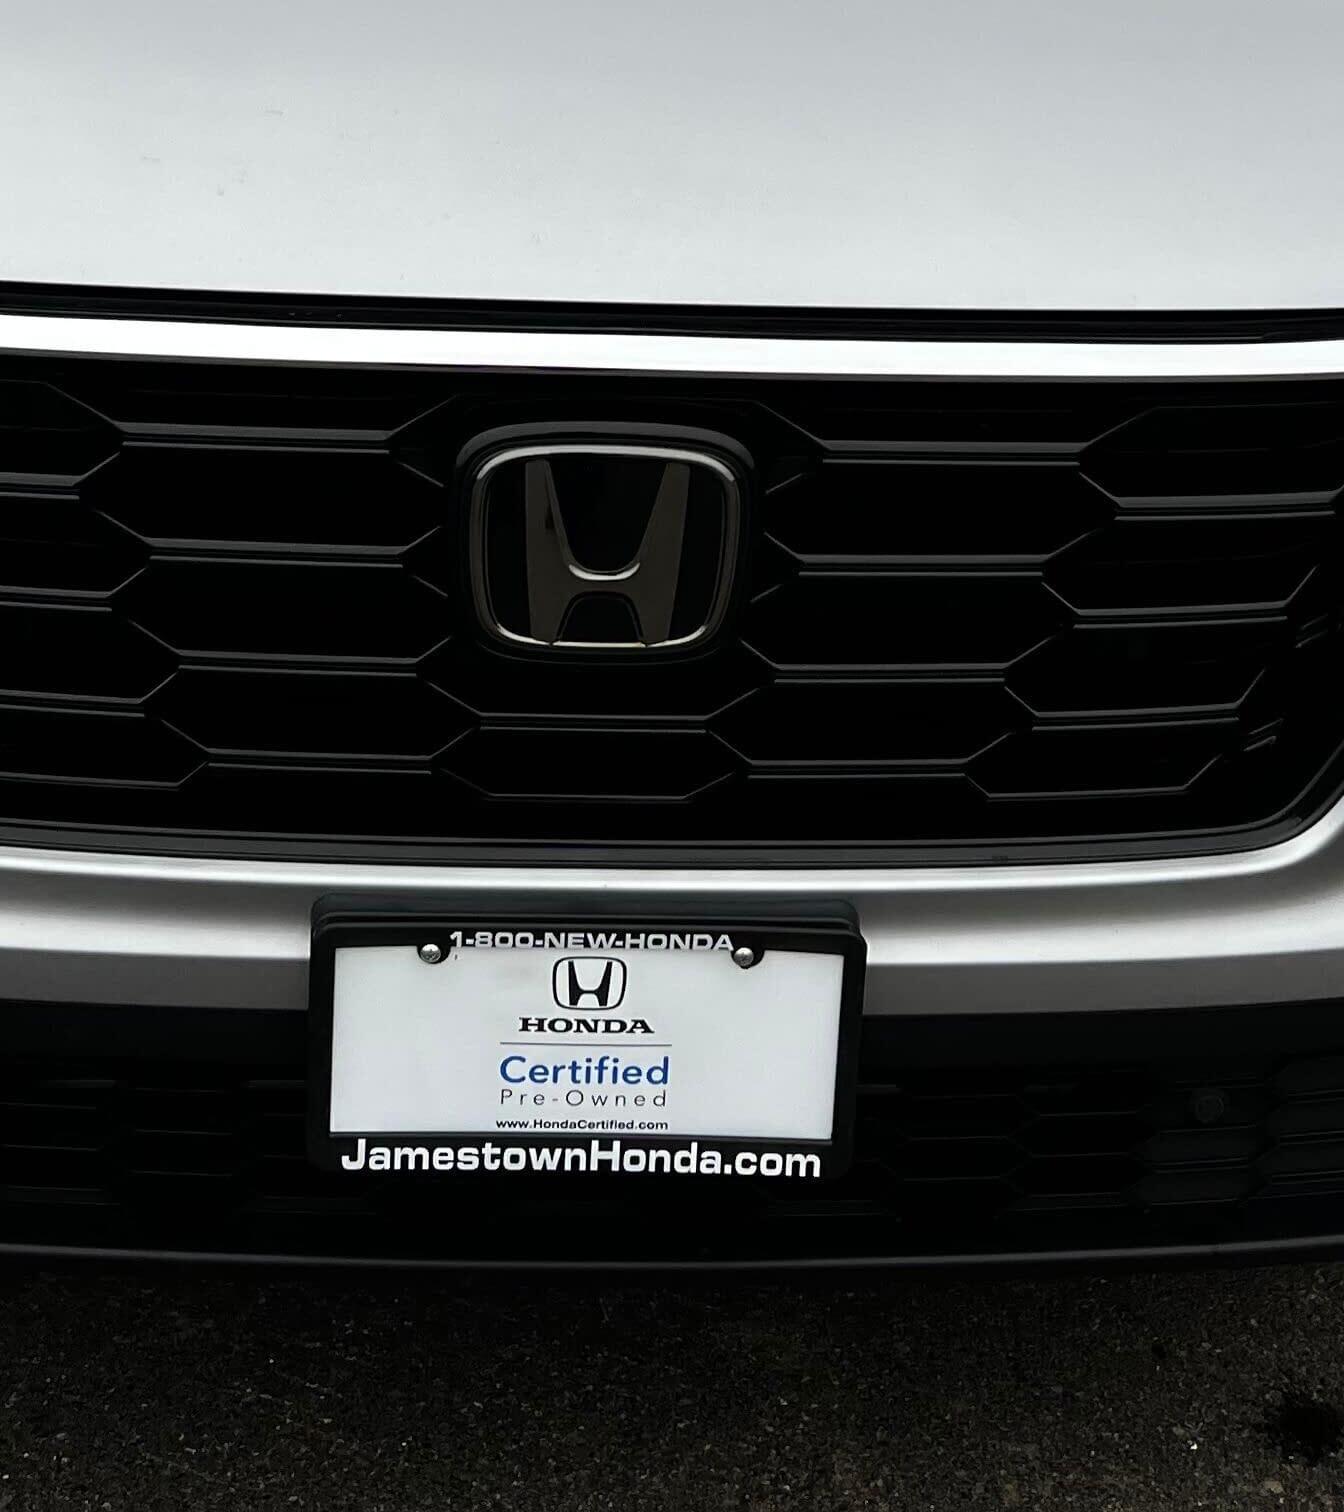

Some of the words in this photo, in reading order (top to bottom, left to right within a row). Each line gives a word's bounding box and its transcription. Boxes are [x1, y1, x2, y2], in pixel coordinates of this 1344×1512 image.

[450, 931, 735, 952] 1-800-NEW-HONDA
[519, 1017, 655, 1034] HONDA
[499, 1055, 669, 1085] Certified
[500, 1088, 667, 1107] Pre-Owned
[496, 1118, 668, 1130] www.HondaCertified.com
[341, 1138, 822, 1178] JamestownHonda.com
